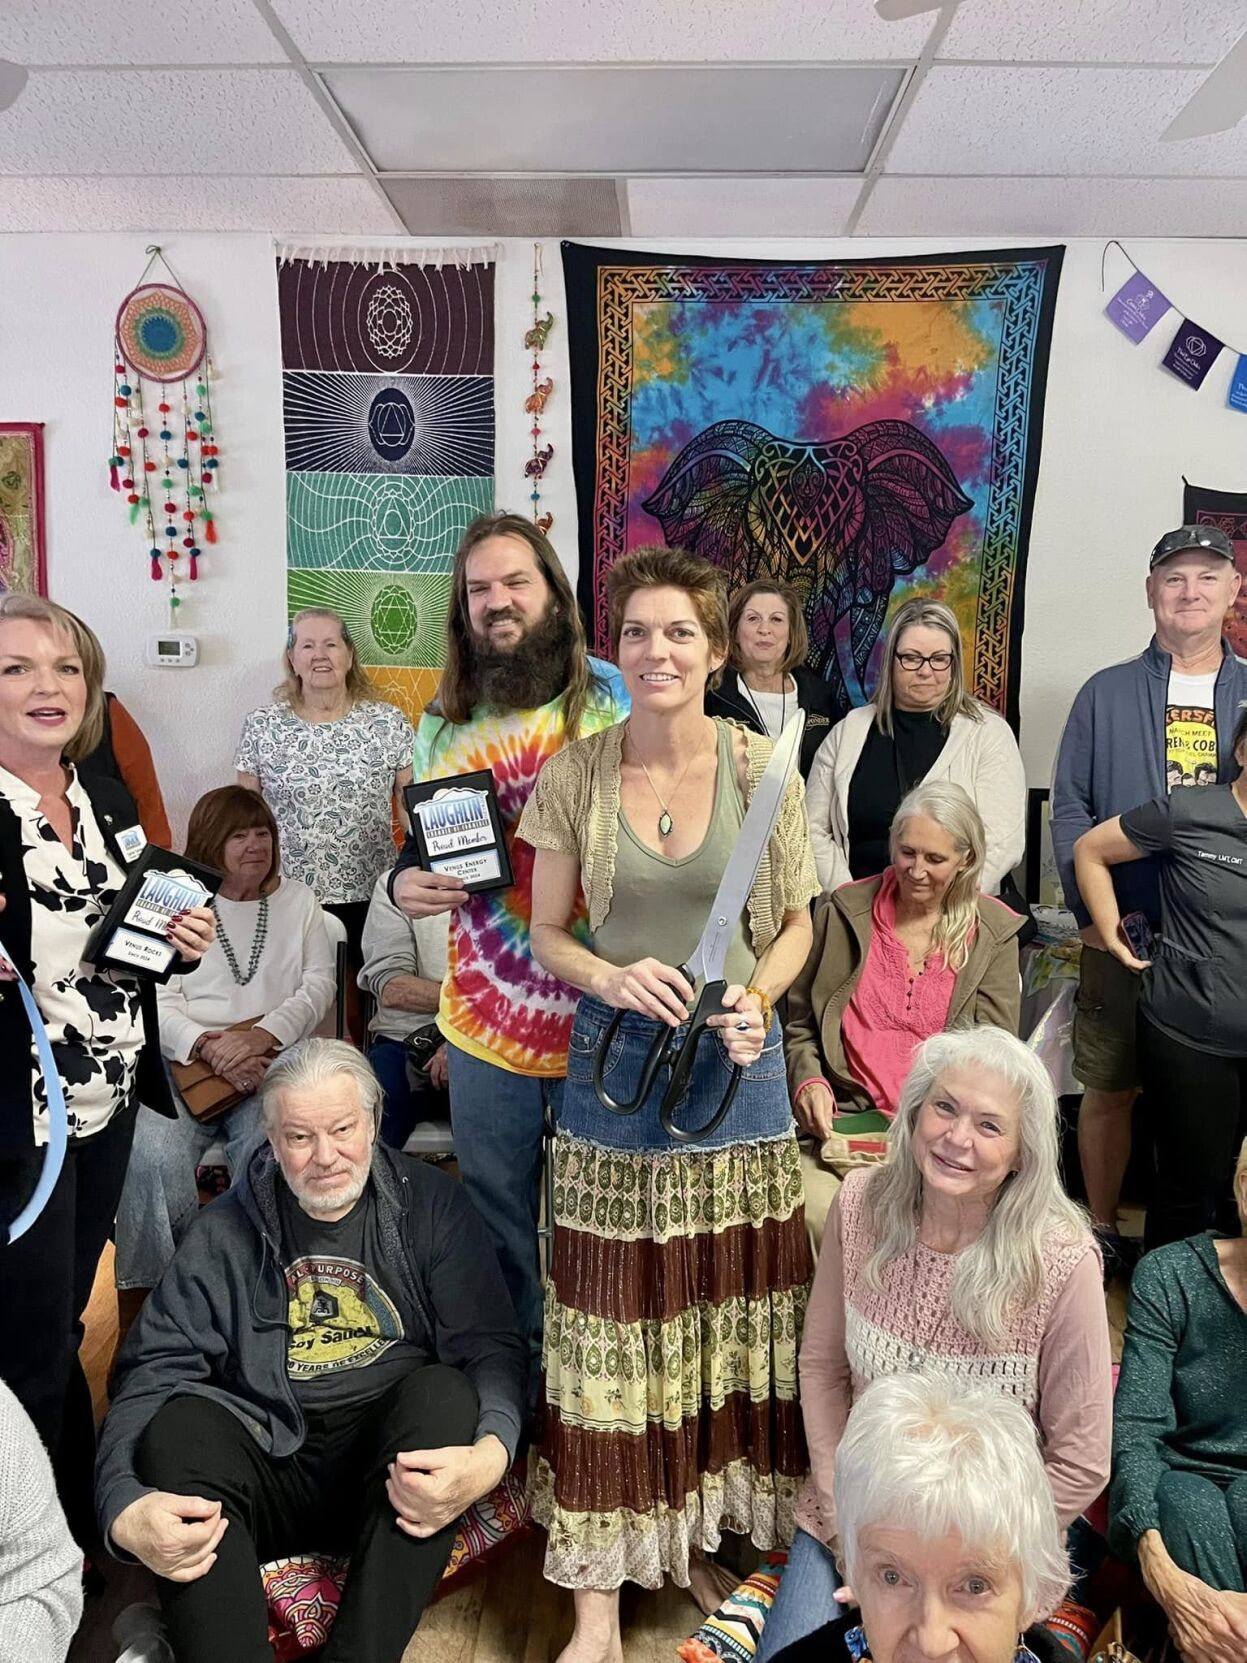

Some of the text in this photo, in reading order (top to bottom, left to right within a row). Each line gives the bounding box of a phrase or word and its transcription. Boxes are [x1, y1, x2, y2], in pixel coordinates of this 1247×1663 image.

[422, 797, 484, 831] LAUGHLIN
[432, 832, 487, 852] Proud Member
[443, 859, 487, 872] VENUS ENERGY
[457, 867, 477, 876] CENTER
[125, 940, 142, 951] VENUS
[297, 1363, 329, 1371] YEARS
